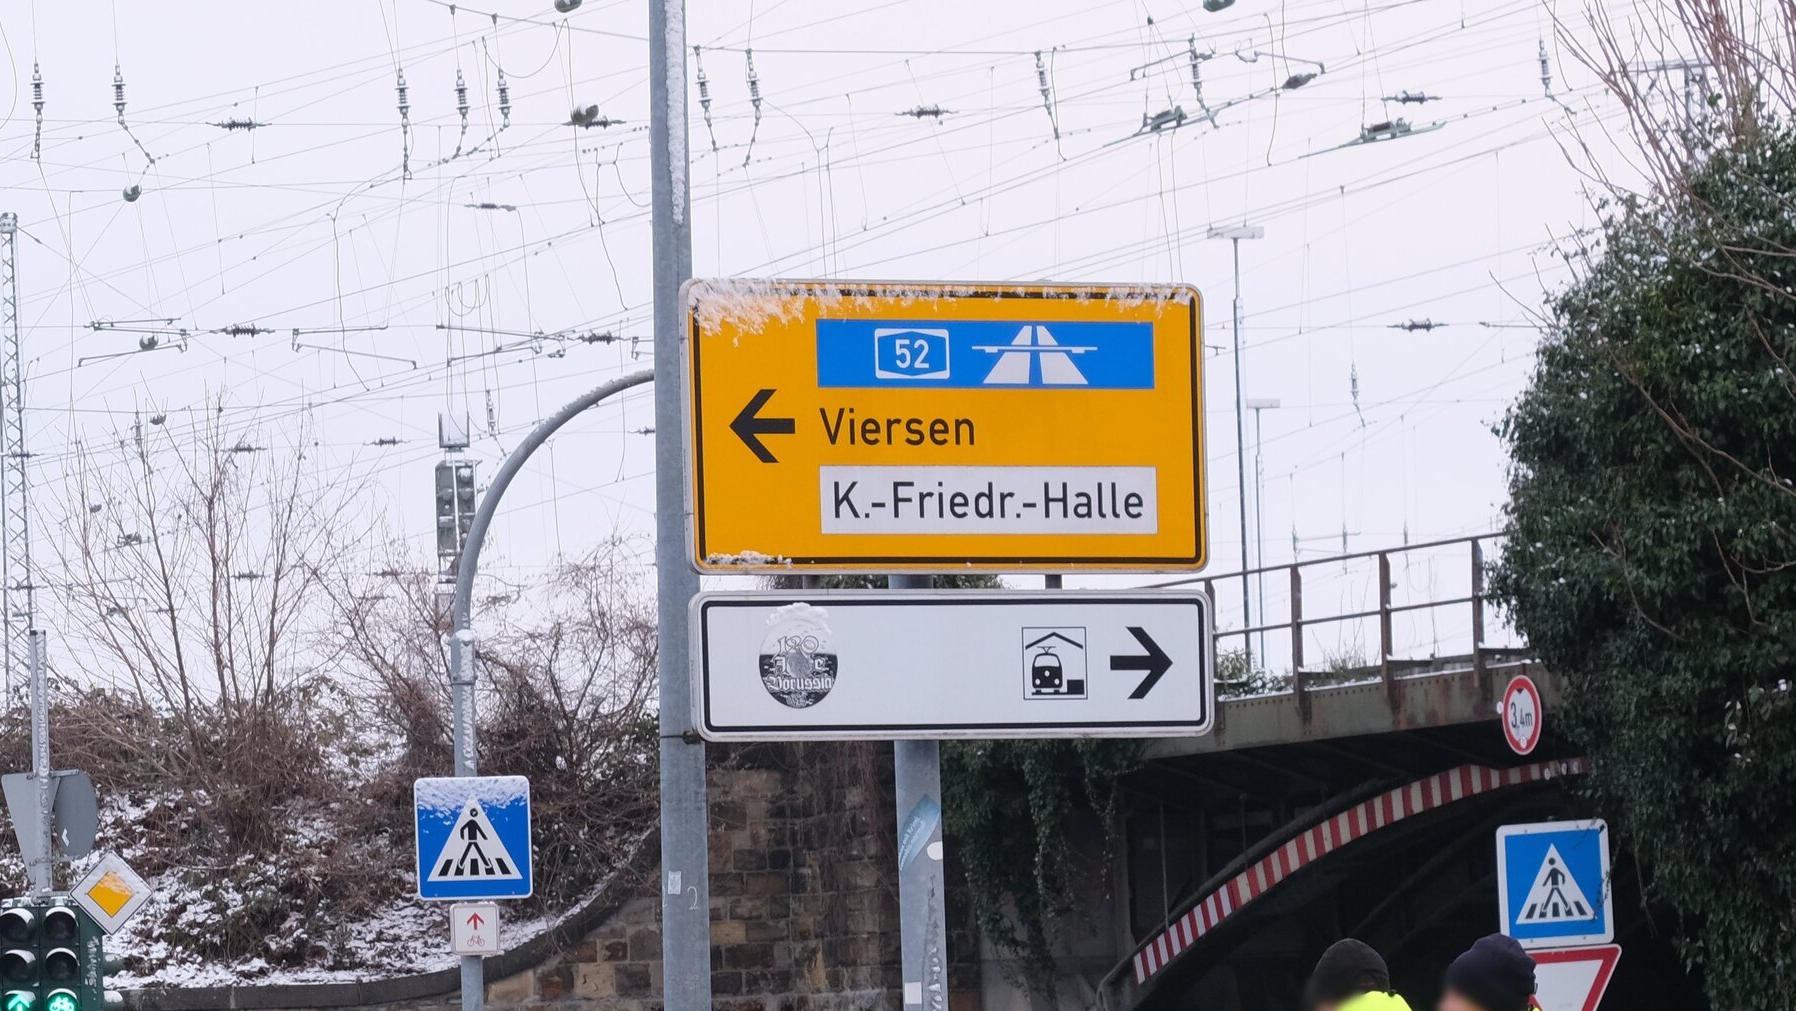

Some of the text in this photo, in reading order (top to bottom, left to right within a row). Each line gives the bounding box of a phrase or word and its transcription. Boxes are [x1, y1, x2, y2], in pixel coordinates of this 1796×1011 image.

[894, 339, 930, 369] 52
[819, 407, 976, 446] Viersen
[833, 481, 1144, 520] K.-Friedr.-Halle
[1510, 702, 1533, 729] 3,4m
